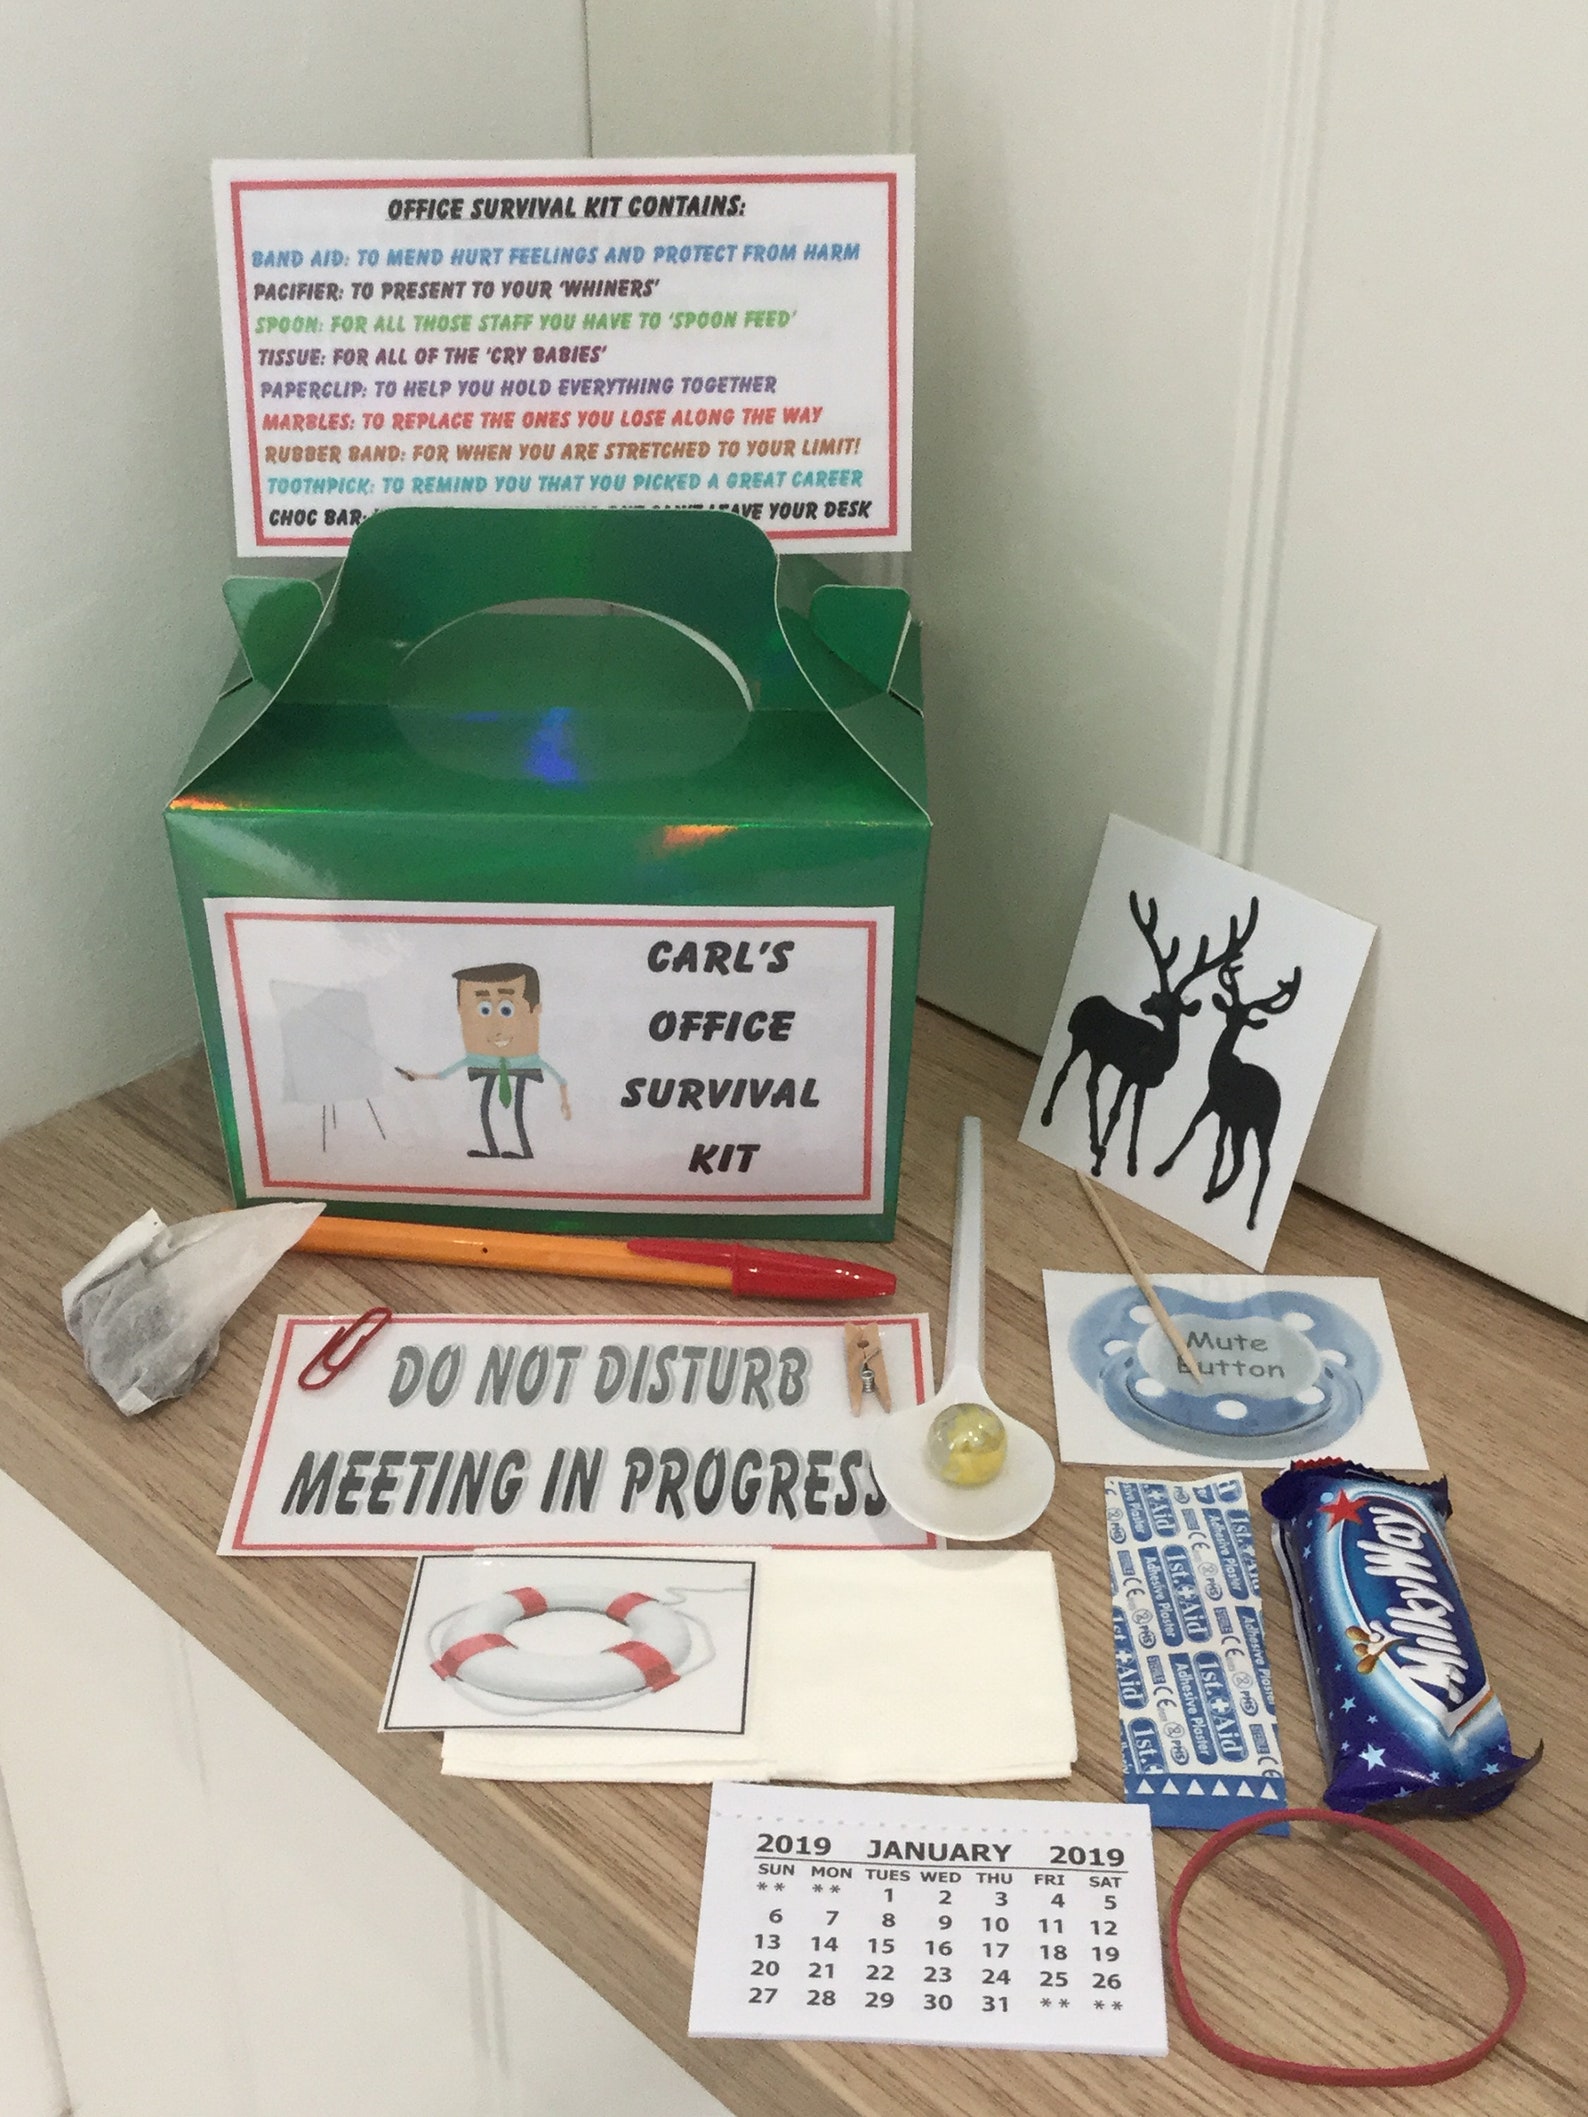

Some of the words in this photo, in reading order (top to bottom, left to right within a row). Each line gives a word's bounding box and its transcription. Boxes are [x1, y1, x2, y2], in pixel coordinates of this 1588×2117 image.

[388, 198, 464, 221] OFFICE
[469, 196, 577, 220] SURVIVAL
[584, 196, 623, 219] KIT
[627, 194, 746, 218] CONTAINS:
[251, 249, 304, 268] BAND
[310, 249, 349, 267] AID:
[357, 249, 380, 267] TO
[386, 248, 444, 267] MEND
[450, 247, 504, 267] HURT
[509, 246, 599, 265] FEELINGS
[604, 245, 646, 264] AND
[653, 244, 738, 264] PROTECT
[742, 243, 797, 263] FROM
[803, 243, 860, 262] HARM
[254, 282, 344, 302] PACIFIER:
[351, 282, 374, 300] TO
[381, 281, 467, 301] PRESENT
[472, 281, 495, 299] TO
[502, 280, 552, 300] YOUR
[559, 278, 660, 298] 'WHINERS'
[255, 315, 323, 334] SPOON:
[331, 315, 367, 333] FOR
[373, 315, 405, 333] ALL
[414, 314, 472, 333] THOSE
[478, 313, 534, 332] STAFF
[540, 313, 577, 331] YOU
[582, 312, 633, 331] HAVE
[639, 311, 661, 331] TO
[669, 311, 738, 330] 'SPOON
[744, 310, 797, 328] FEED'
[258, 348, 326, 366] TISSUE:
[333, 348, 369, 366] FOR
[375, 348, 407, 365] ALL
[415, 347, 439, 365] OF
[444, 347, 480, 365] THE
[486, 346, 527, 366] 'CRY
[533, 345, 607, 364] BABIES'
[261, 381, 367, 400] PAPERCLIP:
[375, 380, 397, 398] TO
[403, 380, 452, 398] HELP
[458, 380, 495, 397] YOU
[500, 379, 551, 397] HOLD
[558, 377, 674, 397] EVERYTHING
[681, 375, 777, 394] TOGETHER
[262, 413, 354, 432] MARBLES:
[362, 413, 384, 430] TO
[392, 412, 474, 431] REPLACE
[480, 411, 516, 429] THE
[522, 410, 572, 429] ONES
[578, 410, 614, 428] YOU
[620, 408, 666, 428] LOSE
[671, 408, 735, 427] ALONG
[742, 407, 776, 425] THE
[783, 406, 823, 424] WAY
[265, 445, 341, 464] RUBBER
[348, 445, 406, 462] BAND:
[412, 444, 449, 463] FOR
[457, 444, 512, 461] WHEN
[519, 443, 556, 461] YOU
[560, 442, 599, 462] ARE
[604, 441, 711, 460] STRETCHED
[718, 440, 740, 458] TO
[747, 439, 796, 458] YOUR
[802, 437, 861, 456] LIMIT!
[268, 476, 375, 495] TOOTHPICK:
[382, 477, 405, 494] TO
[411, 476, 488, 495] REMIND
[495, 475, 532, 493] YOU
[538, 474, 585, 492] THAT
[590, 473, 626, 492] YOU
[633, 473, 701, 492] PICKED
[707, 473, 719, 489] A
[726, 470, 787, 490] GREAT
[792, 469, 864, 488] CAREER
[269, 509, 318, 527] CHOC
[769, 501, 818, 520] YOUR
[824, 500, 872, 519] DESK
[647, 940, 795, 976] CARL'S
[649, 1010, 795, 1042] OFFICE
[620, 1078, 820, 1111] SURVIVAL
[688, 1144, 760, 1175] KIT
[1186, 1331, 1268, 1352] Mute
[387, 1344, 465, 1407] DO
[475, 1346, 584, 1405] NOT
[594, 1346, 812, 1410] DISTURB
[281, 1449, 523, 1516] MEETING
[541, 1448, 604, 1515] IN
[1149, 1500, 1173, 1530] Aid
[1357, 1508, 1438, 1585] Way
[1143, 1556, 1164, 1601] Adhesive
[1156, 1602, 1175, 1638] Plaster
[1165, 1554, 1187, 1584] 1st.
[1178, 1601, 1205, 1634] Aid
[1387, 1579, 1469, 1705] Milky
[1174, 1662, 1196, 1714] Adhesive
[1192, 1717, 1209, 1756] Plaster
[1197, 1662, 1223, 1695] 1st.
[1213, 1716, 1242, 1753] Aid
[757, 1834, 831, 1855] 2019
[867, 1840, 1011, 1862] JANUARY
[1050, 1846, 1124, 1867] 2019
[758, 1863, 795, 1876] SUN
[811, 1865, 853, 1879] MON
[865, 1868, 911, 1882] TUES
[920, 1871, 962, 1883] WED
[975, 1872, 1013, 1885] THU
[1034, 1873, 1065, 1886] FRI
[1089, 1876, 1122, 1889] SAT
[884, 1888, 893, 1903] 1
[938, 1889, 952, 1905] 2
[995, 1891, 1008, 1907] 3
[1050, 1893, 1066, 1908] 4
[1104, 1895, 1117, 1910] 5
[768, 1908, 783, 1924] 6
[826, 1910, 840, 1926] 7
[881, 1912, 896, 1928] 8
[938, 1915, 953, 1931] 9
[981, 1916, 1010, 1933] 10
[1038, 1918, 1063, 1934] 11
[1090, 1920, 1118, 1936] 12
[754, 1933, 781, 1950] 13
[811, 1936, 839, 1952] 14
[868, 1938, 895, 1955] 15
[925, 1940, 953, 1957] 16
[982, 1942, 1010, 1958] 17
[1039, 1944, 1068, 1961] 18
[1091, 1946, 1120, 1962] 19
[750, 1959, 780, 1977] 20
[808, 1962, 834, 1979] 21
[865, 1964, 895, 1981] 22
[923, 1966, 952, 1983] 23
[982, 1968, 1011, 1985] 24
[1039, 1970, 1069, 1988] 25
[1092, 1972, 1122, 1990] 26
[748, 1987, 778, 2004] 27
[806, 1989, 836, 2007] 28
[864, 1991, 895, 2009] 29
[923, 1993, 953, 2011] 30
[982, 1995, 1008, 2013] 31
